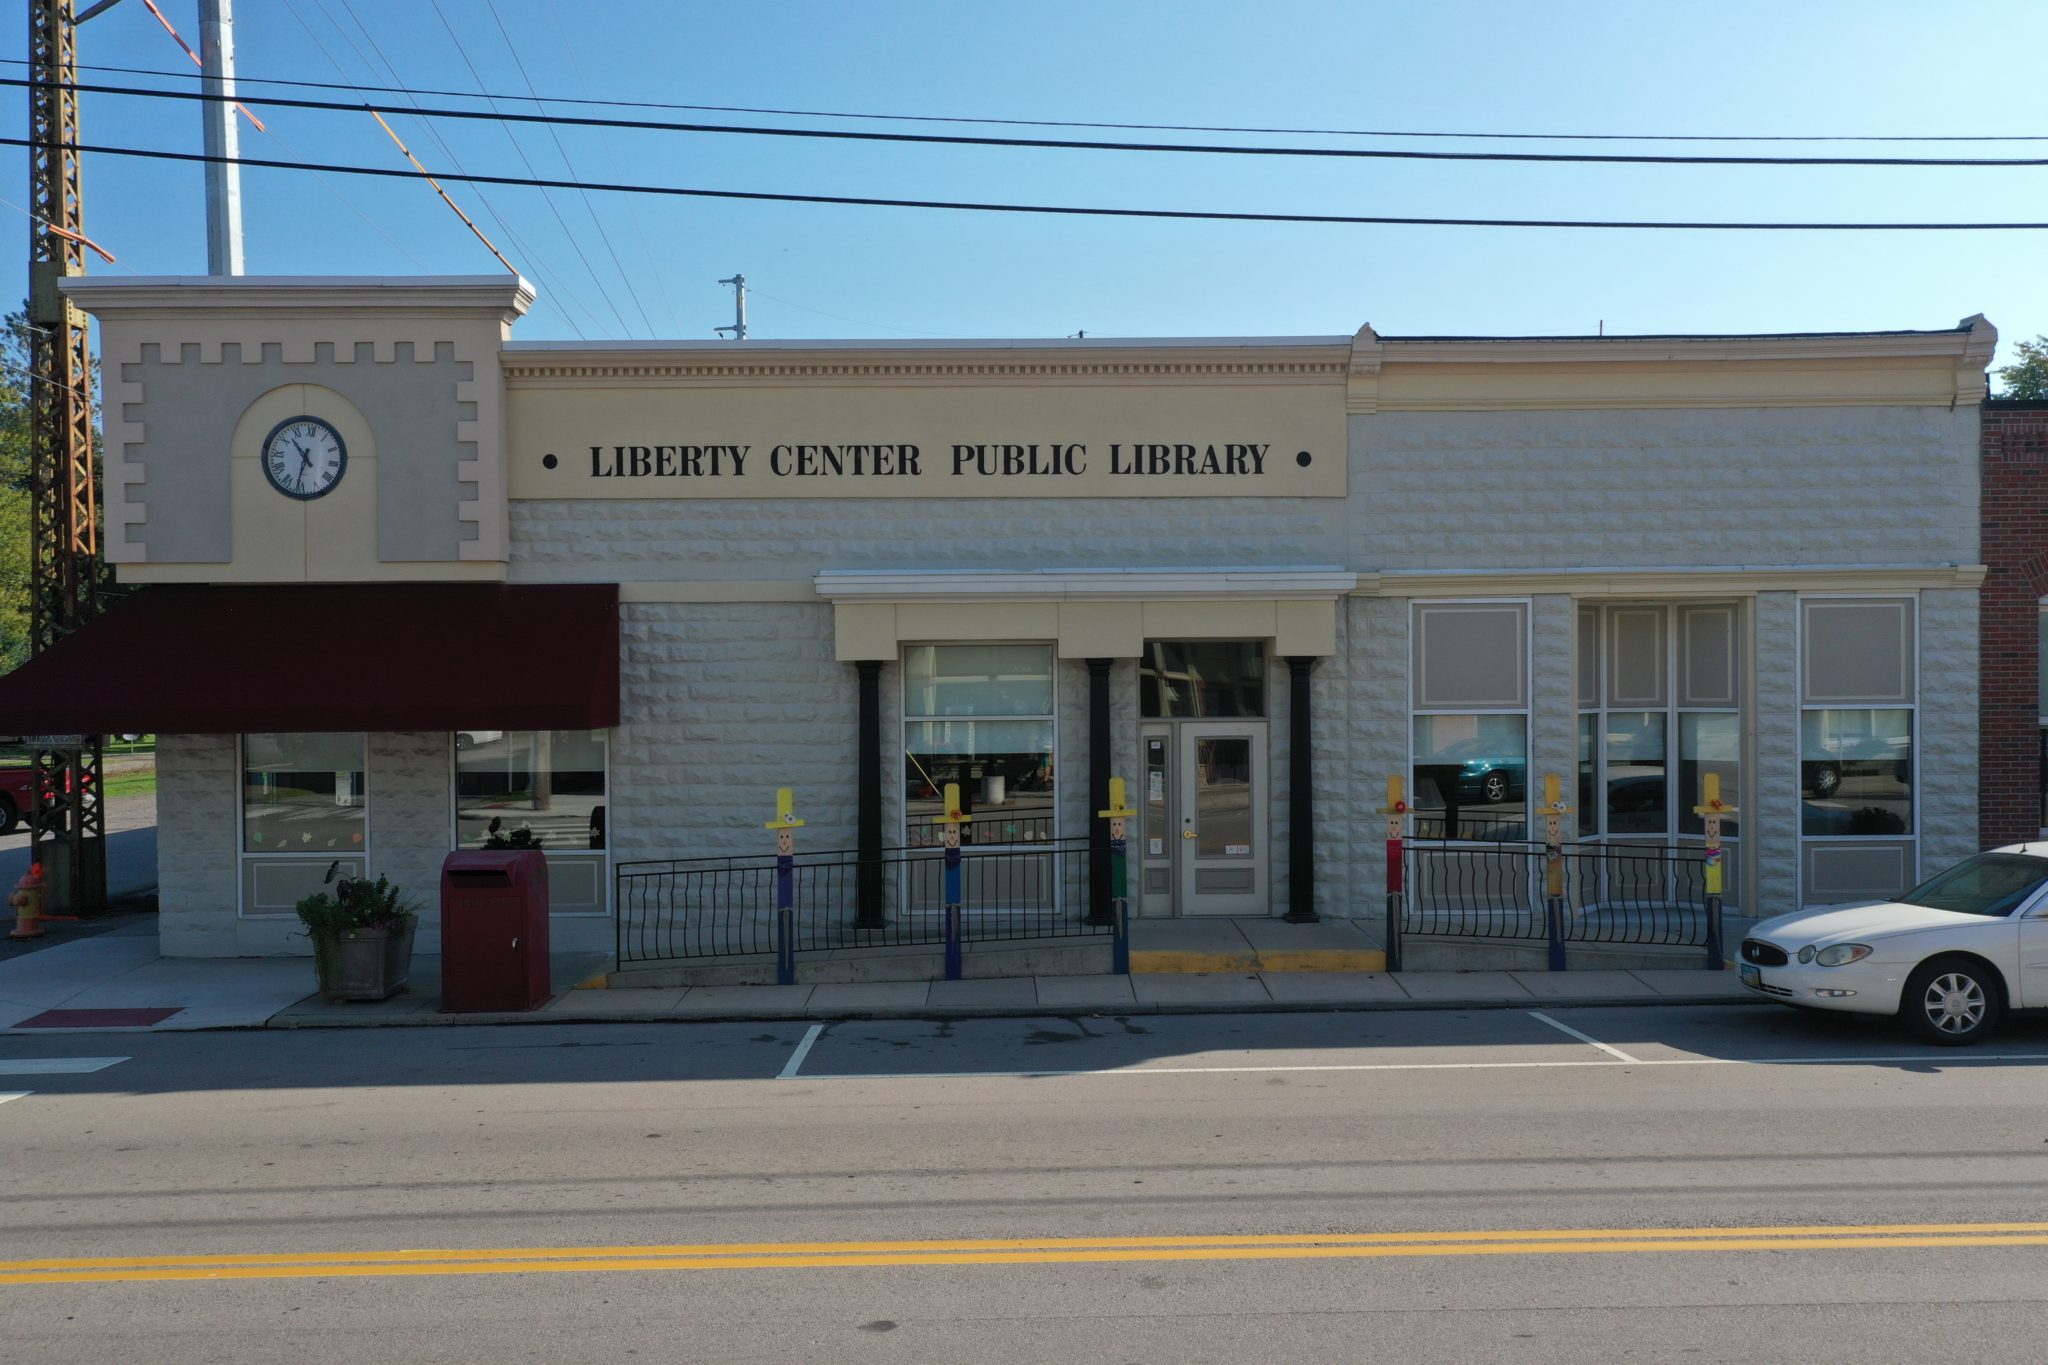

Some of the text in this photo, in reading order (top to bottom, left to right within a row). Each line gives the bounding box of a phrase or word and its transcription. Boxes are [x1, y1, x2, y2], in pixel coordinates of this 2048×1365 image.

[589, 443, 1271, 478] LIBERTY CENTER PUBLIC LIBRARY
